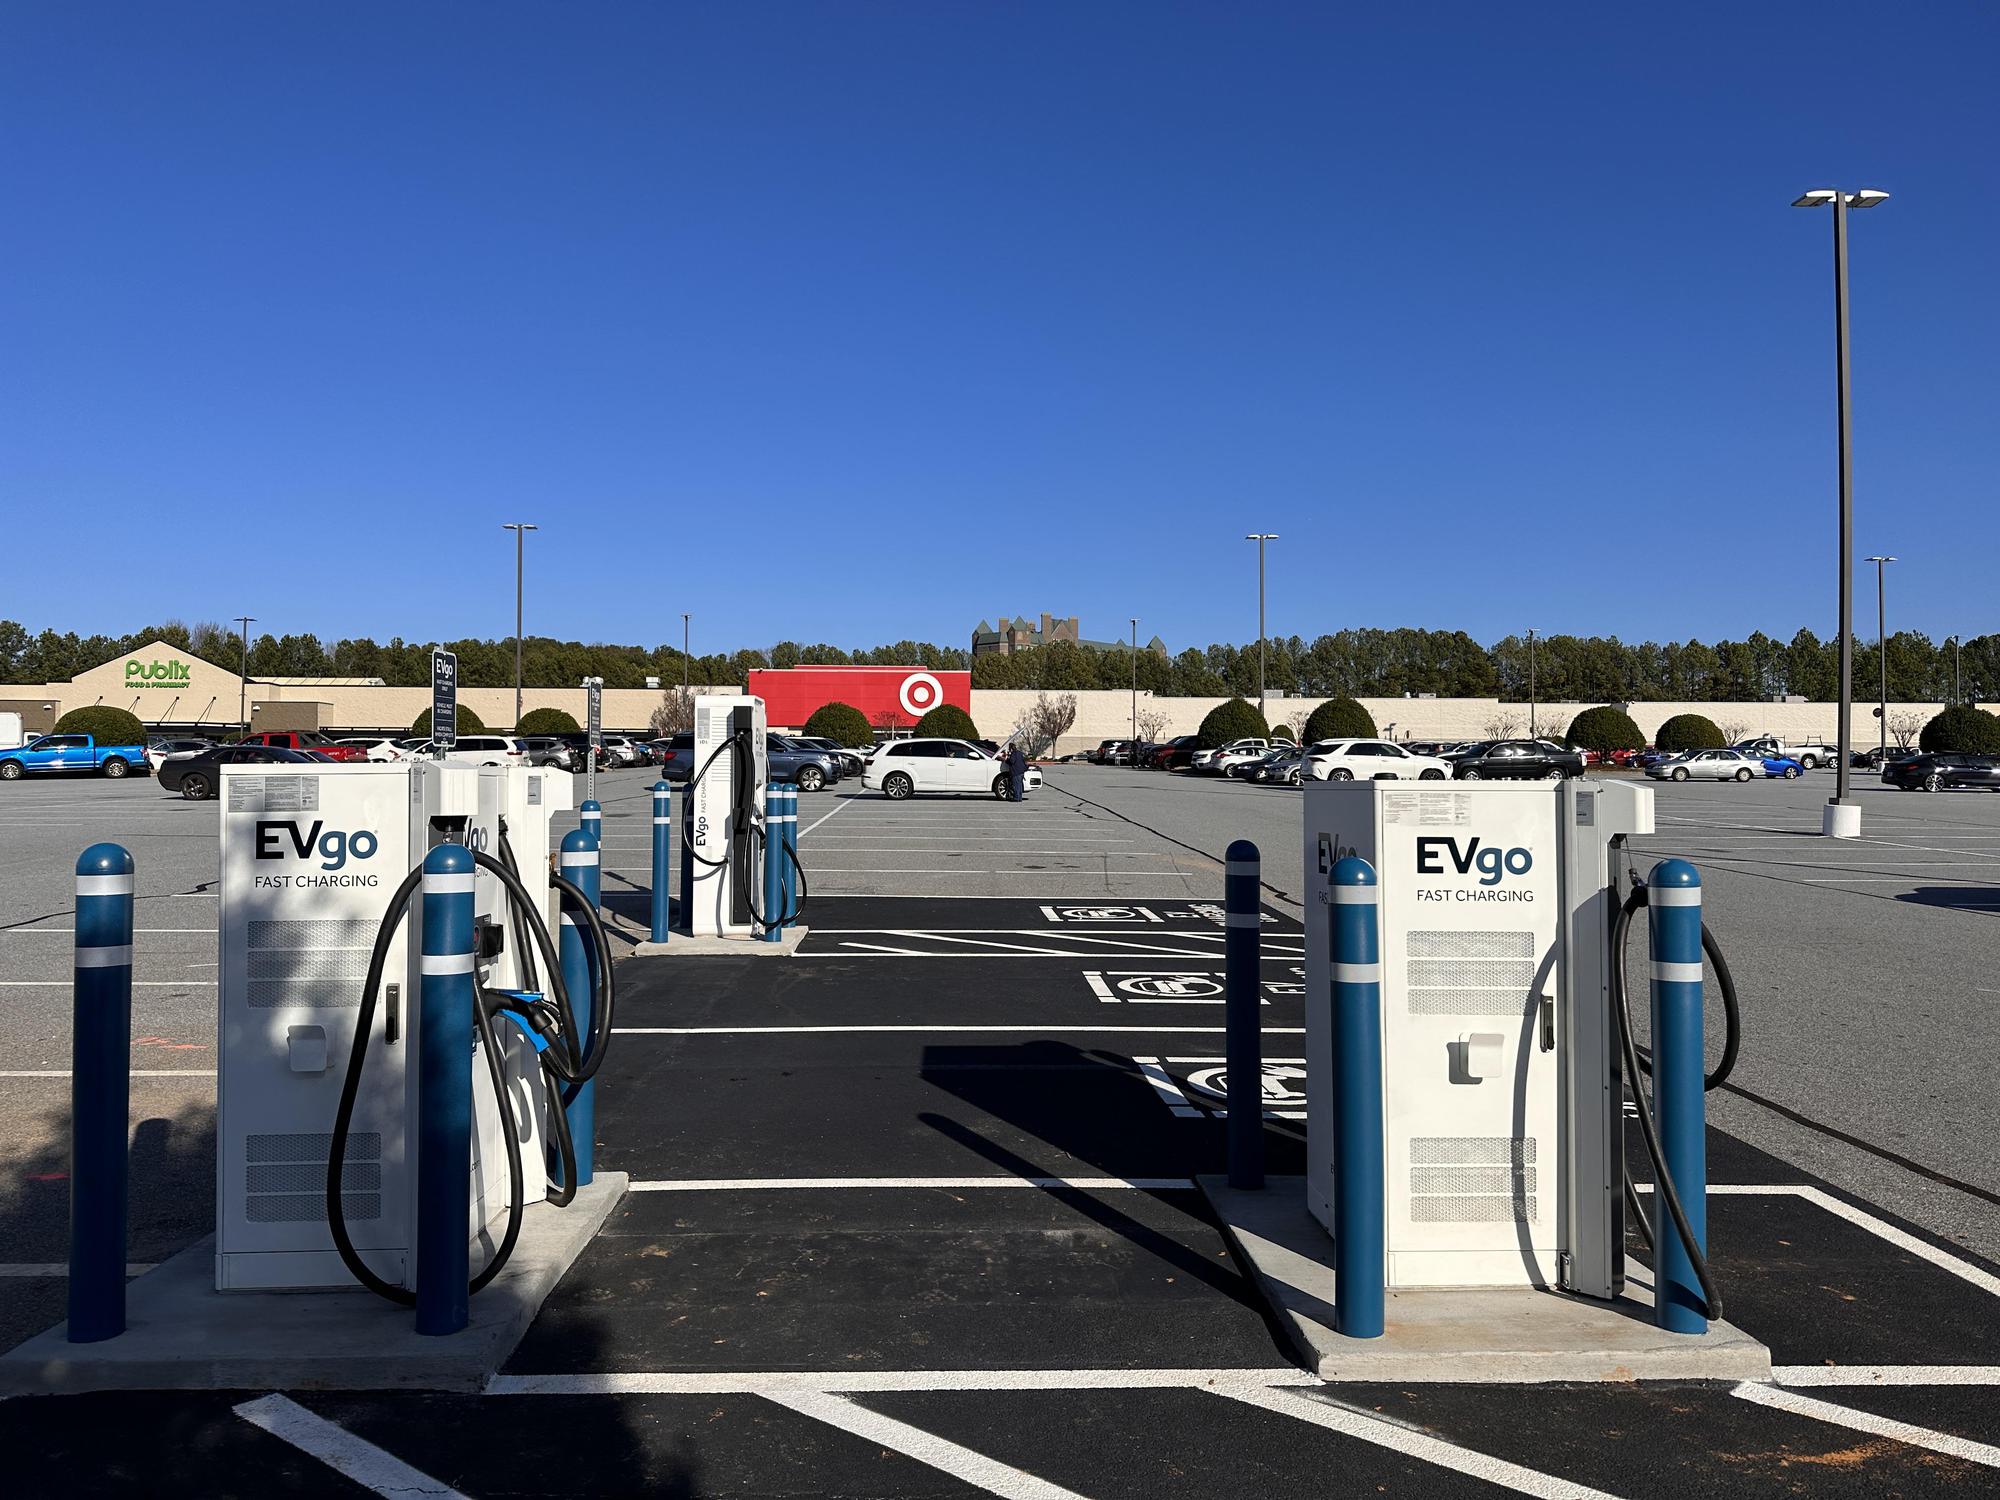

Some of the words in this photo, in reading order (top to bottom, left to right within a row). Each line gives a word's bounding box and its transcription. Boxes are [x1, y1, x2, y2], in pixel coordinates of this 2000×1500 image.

[125, 659, 190, 679] Publix
[436, 658, 453, 679] EVgo
[256, 820, 378, 871] EVgo
[465, 817, 488, 852] Vgo
[696, 816, 709, 846] EVgo
[1319, 832, 1357, 874] EV
[1417, 837, 1533, 886] EVgo
[255, 876, 292, 887] FAST
[295, 875, 378, 887] CHARGING
[1417, 890, 1452, 901] FAST
[1455, 890, 1534, 902] CHARGING
